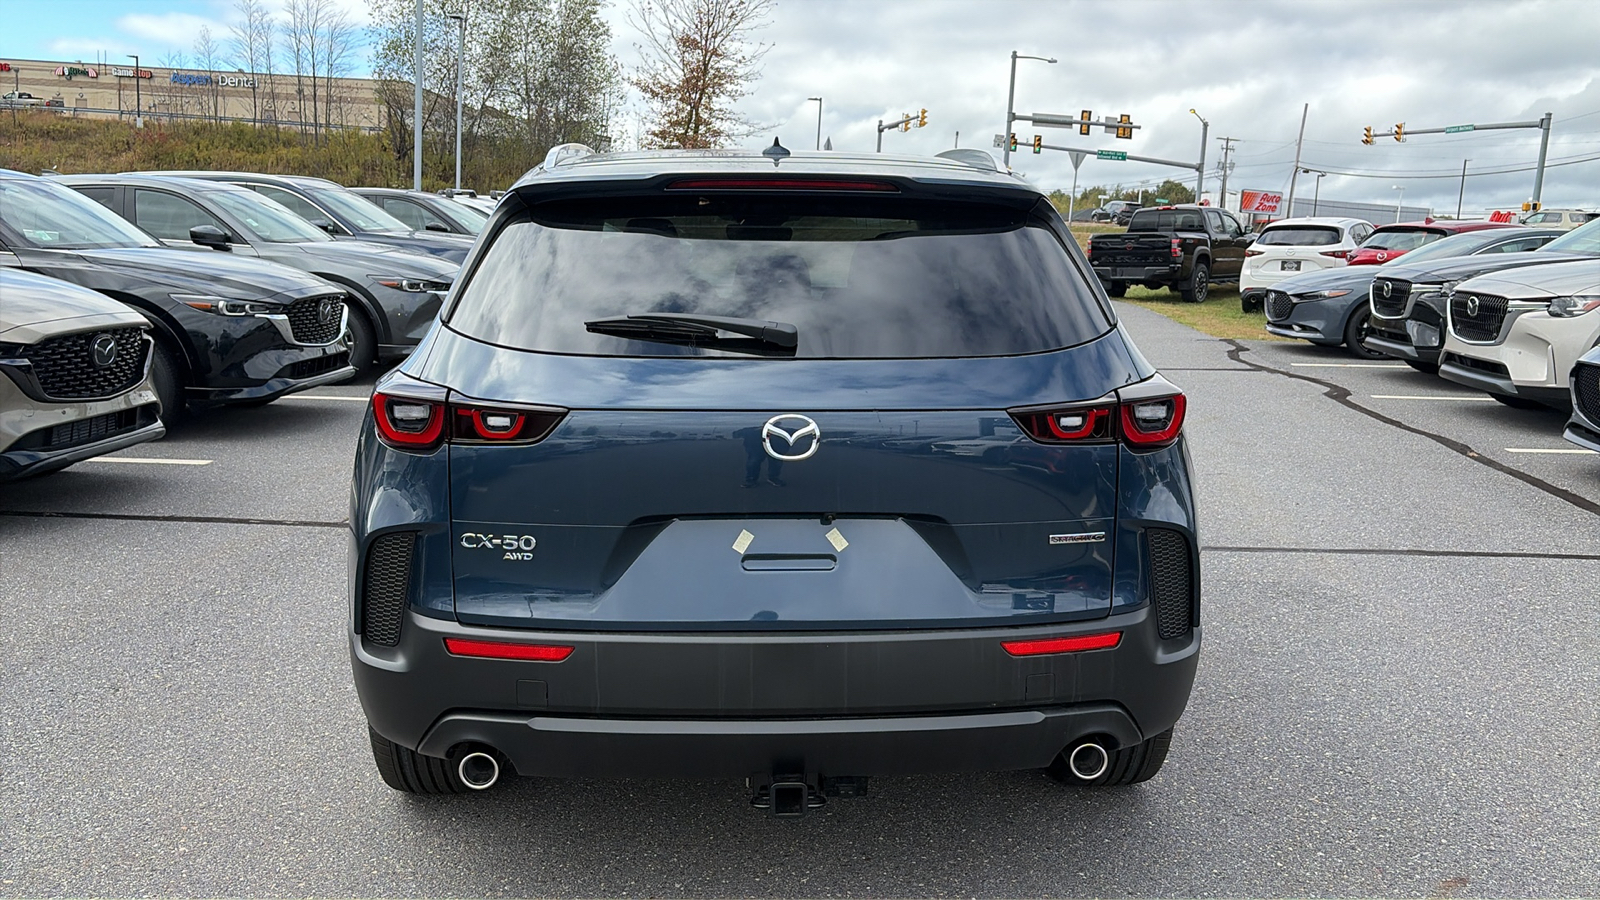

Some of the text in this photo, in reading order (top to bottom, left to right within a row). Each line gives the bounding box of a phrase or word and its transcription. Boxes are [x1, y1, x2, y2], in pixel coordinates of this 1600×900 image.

[111, 67, 153, 79] GameStop
[170, 69, 259, 88] Aspen Dental
[1260, 192, 1282, 204] Auto
[1254, 201, 1278, 213] Zone
[1489, 210, 1516, 223] Aut
[460, 532, 536, 551] CX-50
[503, 552, 533, 561] AWD
